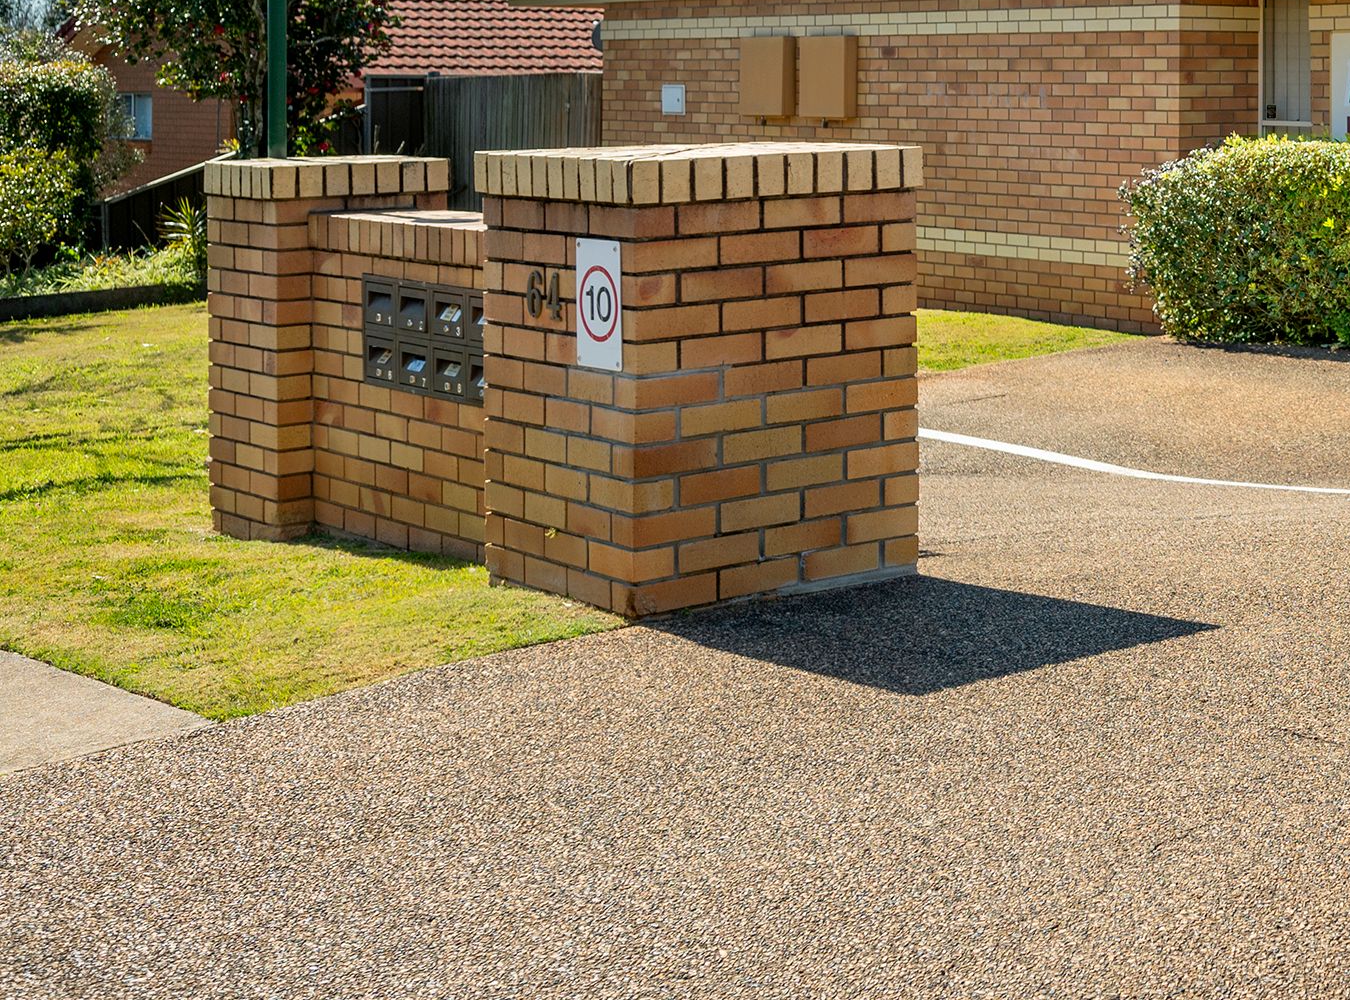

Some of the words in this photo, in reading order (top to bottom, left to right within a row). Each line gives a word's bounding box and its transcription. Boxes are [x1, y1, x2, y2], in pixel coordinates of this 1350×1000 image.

[526, 270, 563, 322] 64
[585, 285, 612, 322] 10
[455, 326, 461, 337] 3
[421, 377, 426, 388] 7
